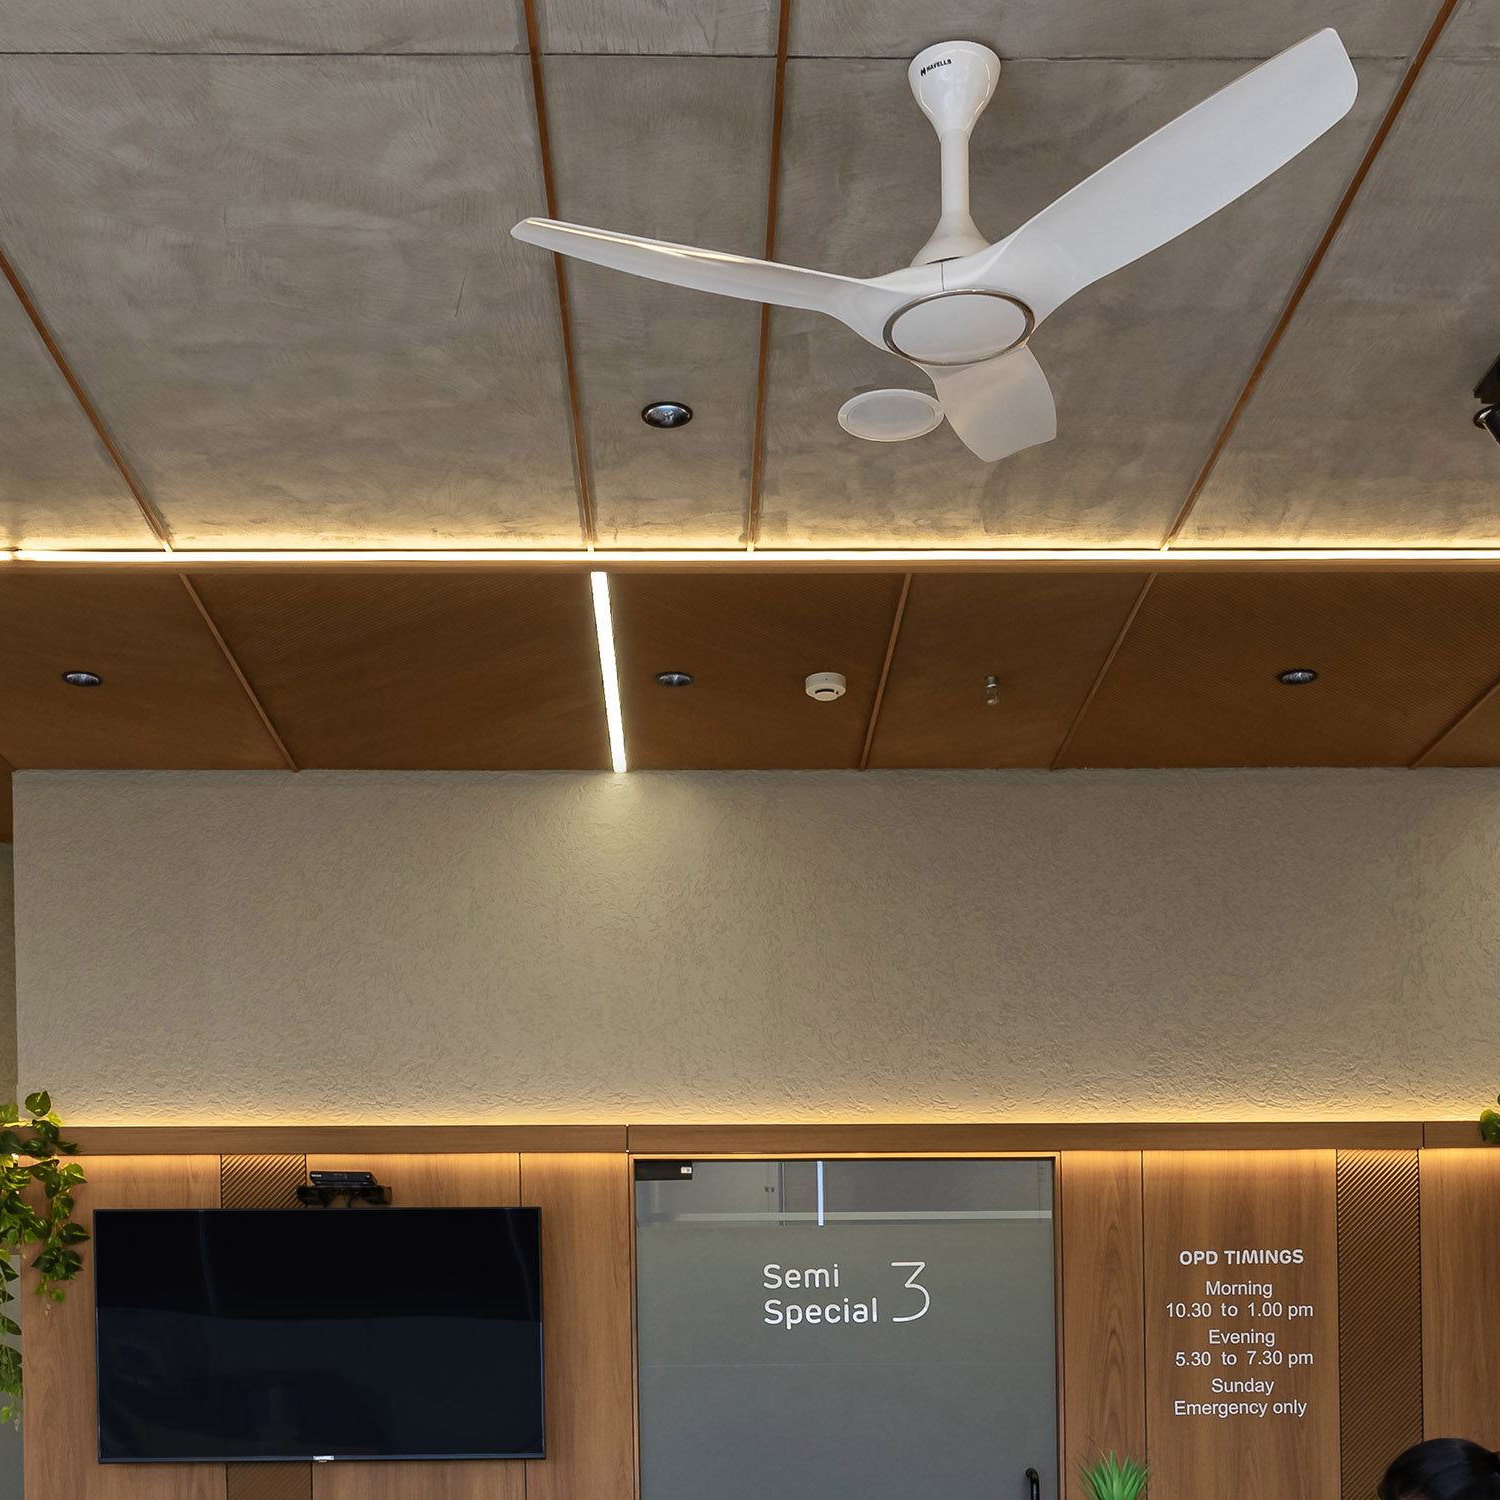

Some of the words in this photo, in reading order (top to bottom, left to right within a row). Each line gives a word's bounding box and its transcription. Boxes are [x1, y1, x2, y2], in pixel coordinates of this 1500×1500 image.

[1179, 1250, 1219, 1266] OPD
[1224, 1248, 1304, 1265] TIMINGS
[763, 1263, 840, 1290] Semi
[763, 1297, 879, 1330] Special
[891, 1261, 931, 1323] 3
[1205, 1280, 1274, 1299] Morning
[1166, 1302, 1213, 1318] 10.30
[1220, 1302, 1239, 1317] to
[1247, 1301, 1283, 1317] 1.00
[1288, 1305, 1315, 1320] pm
[1208, 1328, 1276, 1348] Evening
[1175, 1351, 1212, 1367] 5.30
[1221, 1351, 1238, 1366] to
[1246, 1350, 1283, 1366] 7.30
[1288, 1353, 1315, 1369] pm
[1211, 1377, 1275, 1396] Sunday
[1174, 1400, 1269, 1419] Emergency
[1272, 1399, 1308, 1418] only
